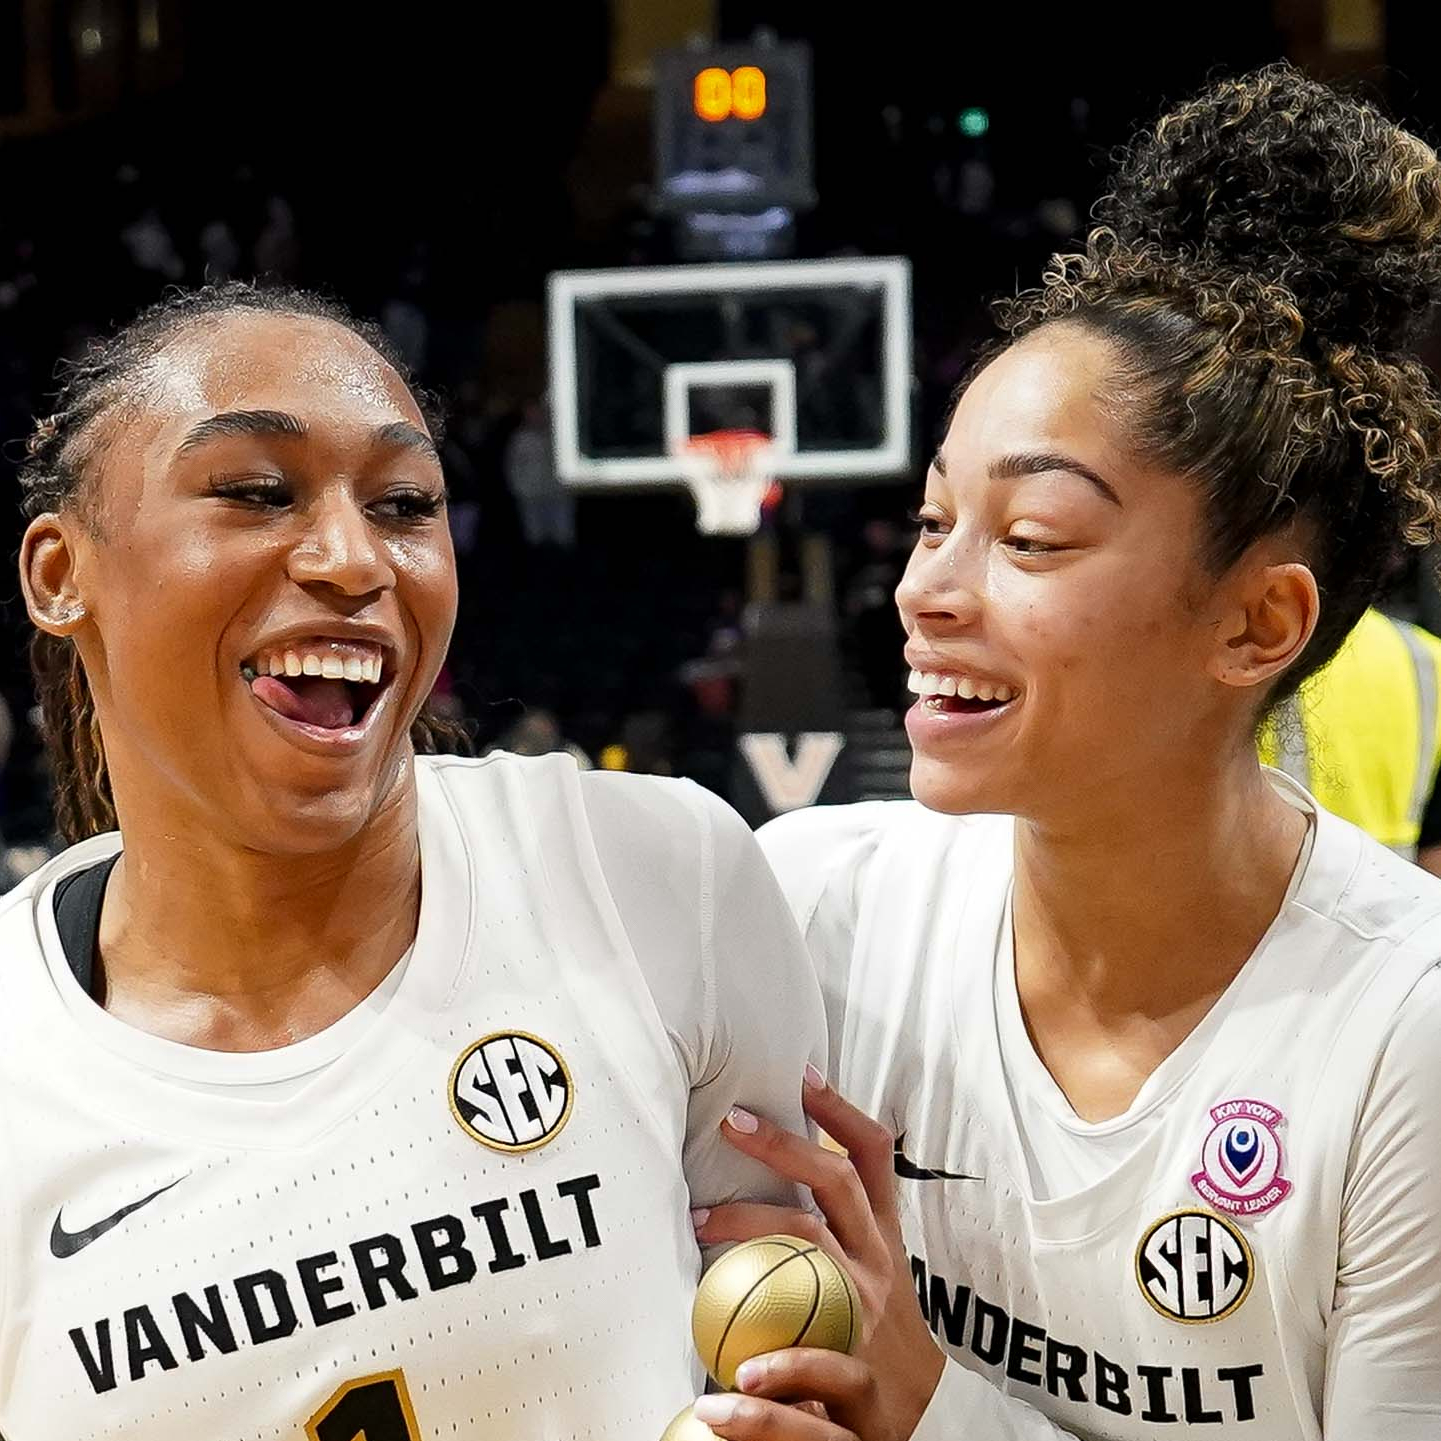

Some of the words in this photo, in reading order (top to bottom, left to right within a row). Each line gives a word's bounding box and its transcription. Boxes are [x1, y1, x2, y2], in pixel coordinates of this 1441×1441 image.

[739, 732, 846, 813] V
[457, 1037, 565, 1143] SEC
[1215, 1102, 1242, 1119] KAY
[1245, 1102, 1276, 1121] YOW
[1197, 1180, 1242, 1210] SERVANT
[1243, 1186, 1283, 1211] LEADER
[68, 1174, 602, 1395] VANDERBILT
[1145, 1216, 1243, 1316] SEC
[910, 1254, 1263, 1424] ANDERBILT
